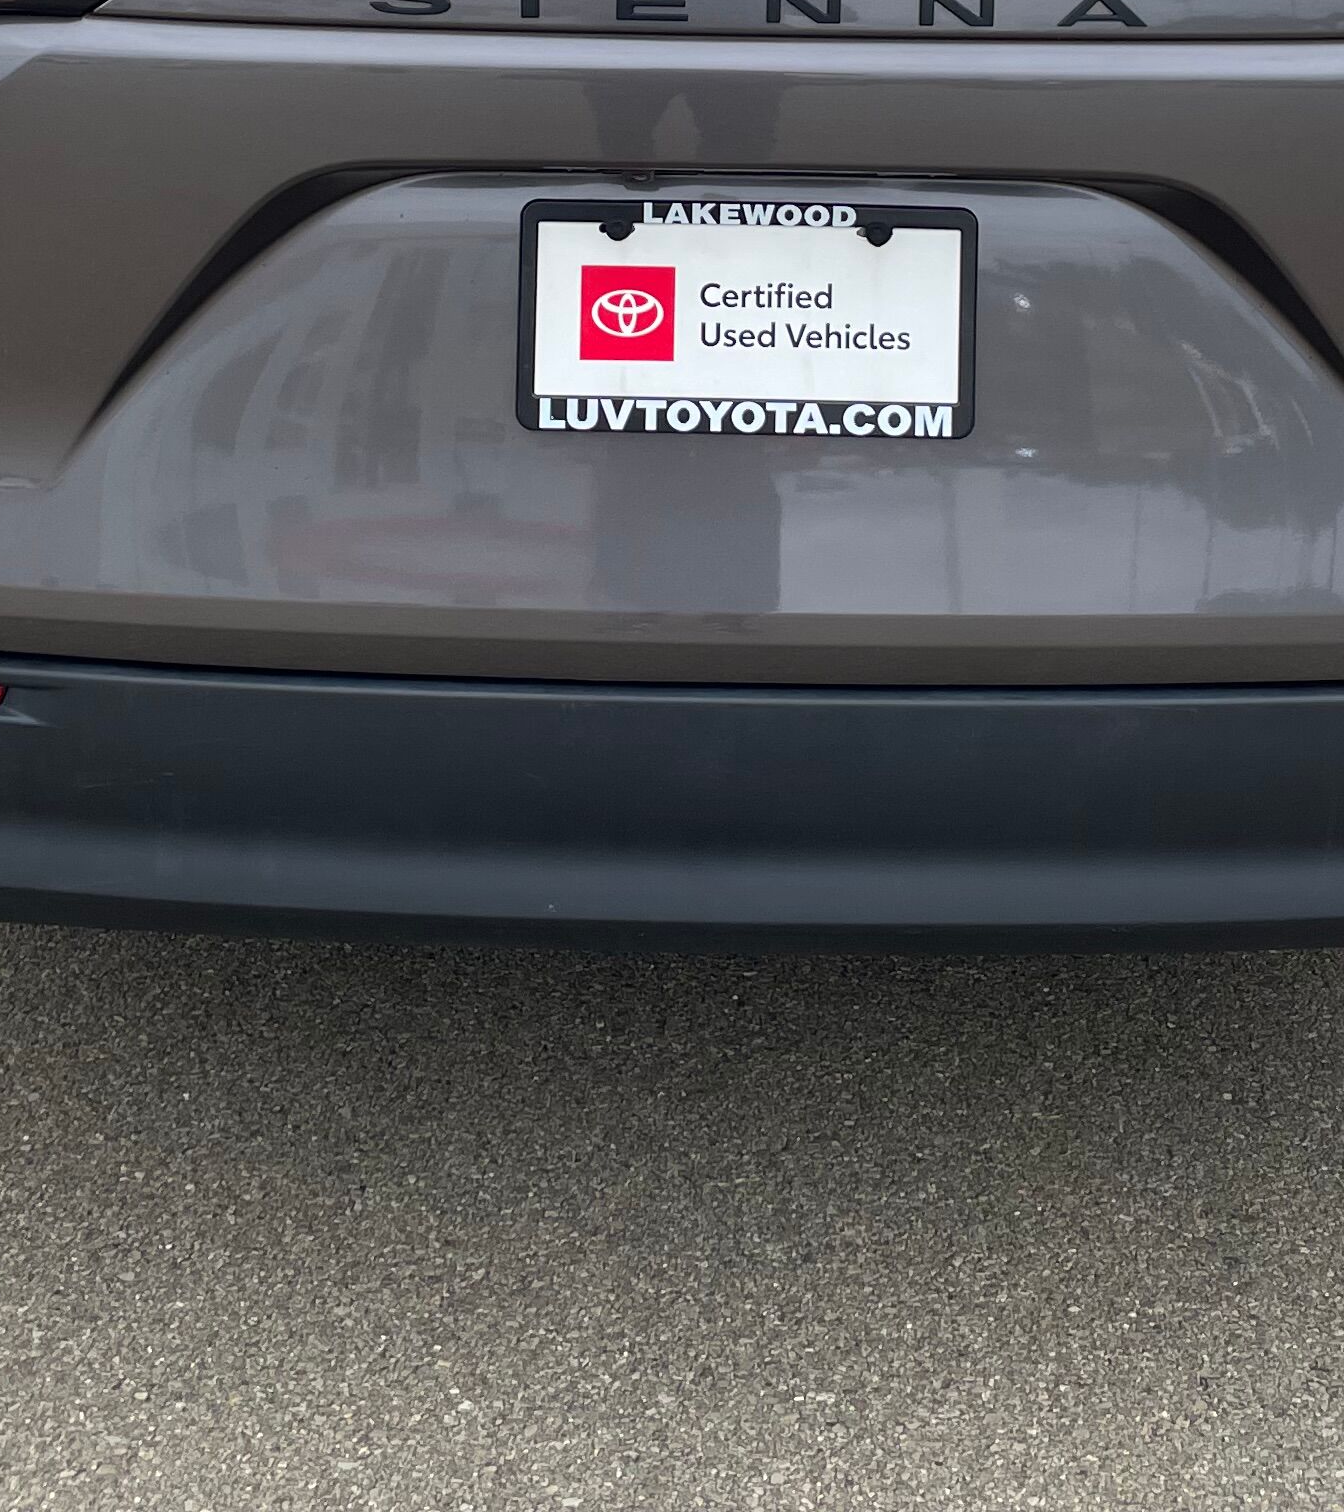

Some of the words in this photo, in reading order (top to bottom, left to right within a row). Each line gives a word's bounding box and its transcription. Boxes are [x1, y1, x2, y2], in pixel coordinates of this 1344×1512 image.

[643, 201, 857, 228] LAKEWOOD
[699, 282, 834, 310] Certified
[700, 321, 777, 349] Used
[785, 323, 912, 351] Vehicles
[538, 396, 954, 438] LUVTOYOTA.COM
